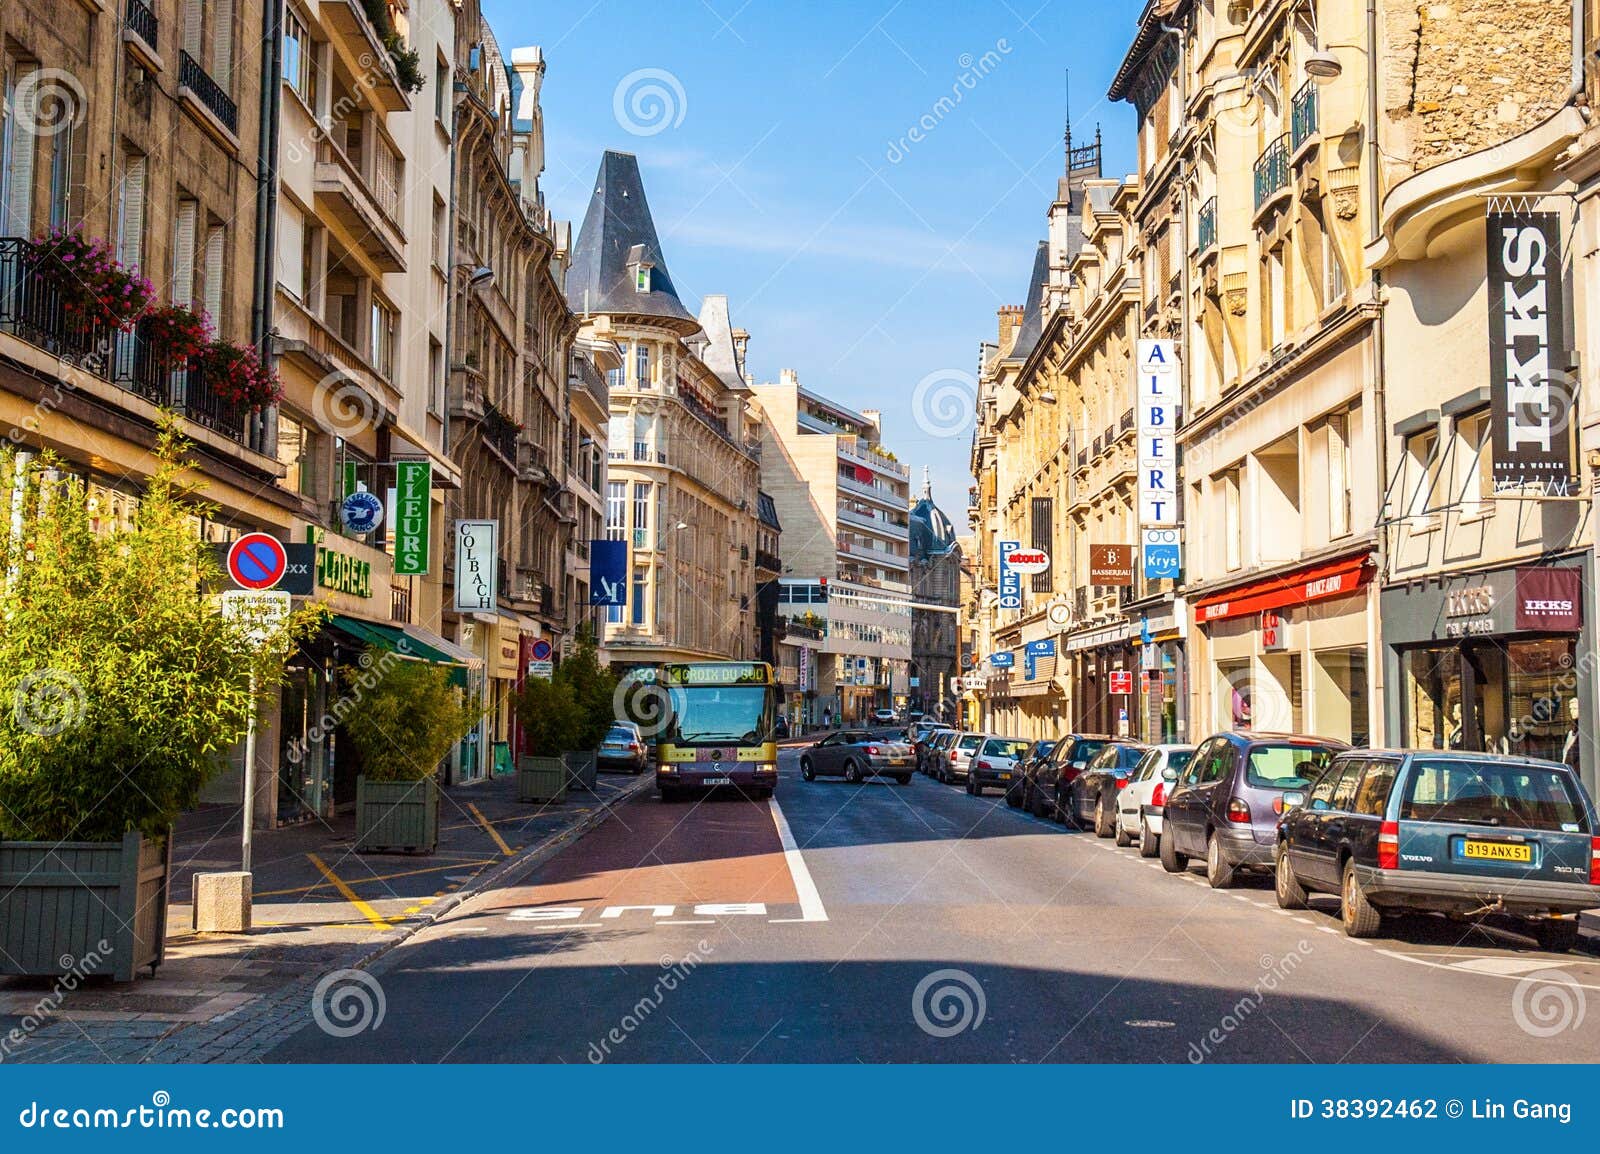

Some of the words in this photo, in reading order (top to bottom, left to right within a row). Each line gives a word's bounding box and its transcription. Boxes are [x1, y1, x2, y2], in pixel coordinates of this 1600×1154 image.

[1502, 226, 1551, 452] IKKS
[1148, 344, 1166, 521] ALBERT
[402, 465, 423, 571] FLEURS
[346, 520, 376, 532] FRANCE
[1107, 550, 1117, 564] B
[1148, 555, 1177, 569] Krys
[460, 523, 491, 609] COLBACH
[1091, 569, 1131, 577] BASSEREAU
[1306, 580, 1325, 598] FRANCE
[1525, 600, 1573, 611] IKKS
[682, 669, 718, 681] CROIX
[722, 669, 737, 681] DU
[742, 669, 764, 681] SUD
[1401, 854, 1433, 862] VOLVO
[1467, 844, 1489, 856] 819
[1491, 846, 1512, 858] ANX
[1514, 848, 1529, 859] 51
[506, 902, 767, 921] BUS
